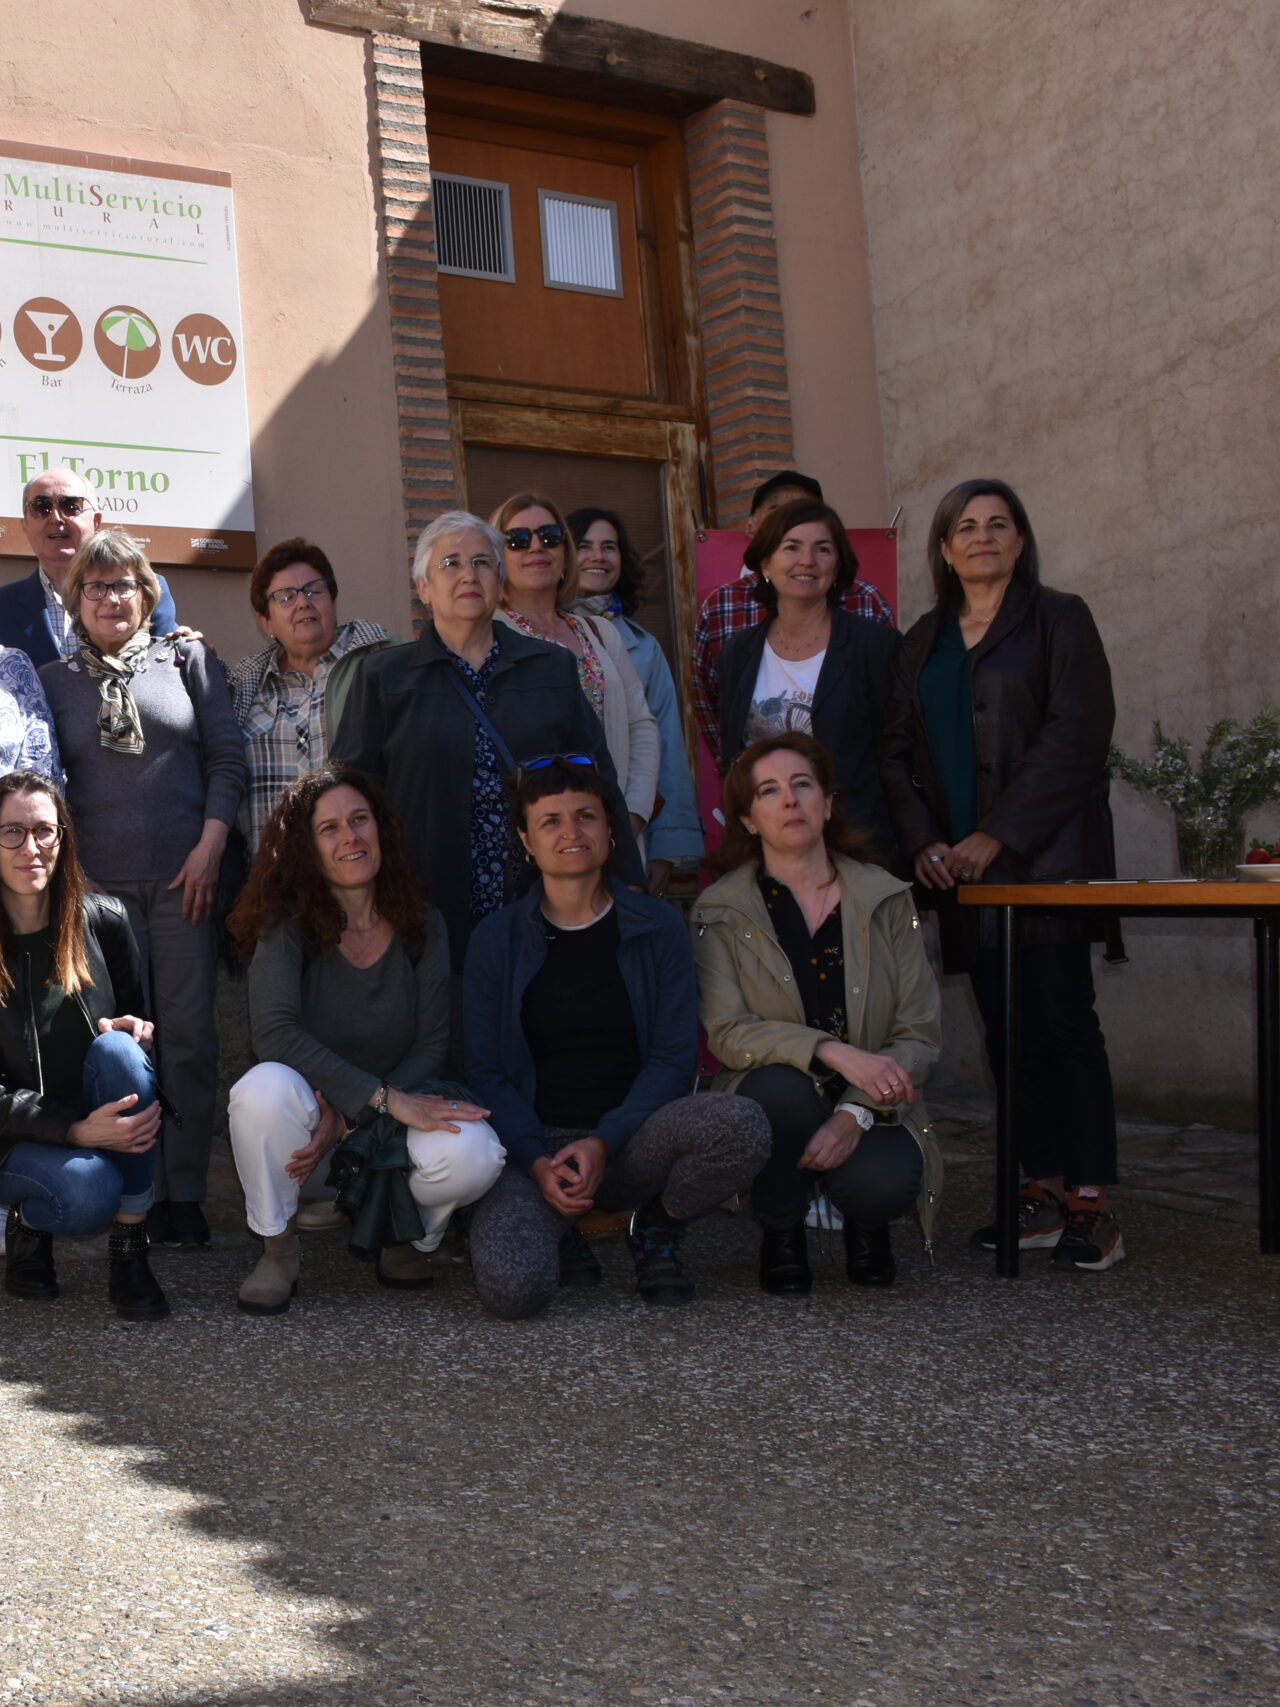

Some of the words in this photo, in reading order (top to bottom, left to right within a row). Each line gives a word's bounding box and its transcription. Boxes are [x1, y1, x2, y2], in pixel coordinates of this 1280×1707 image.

[3, 173, 202, 219] MultiServicio
[4, 200, 203, 235] RURAL
[175, 333, 232, 366] WC
[41, 375, 63, 388] Bar
[109, 377, 153, 395] Terraza
[62, 456, 170, 493] Torno
